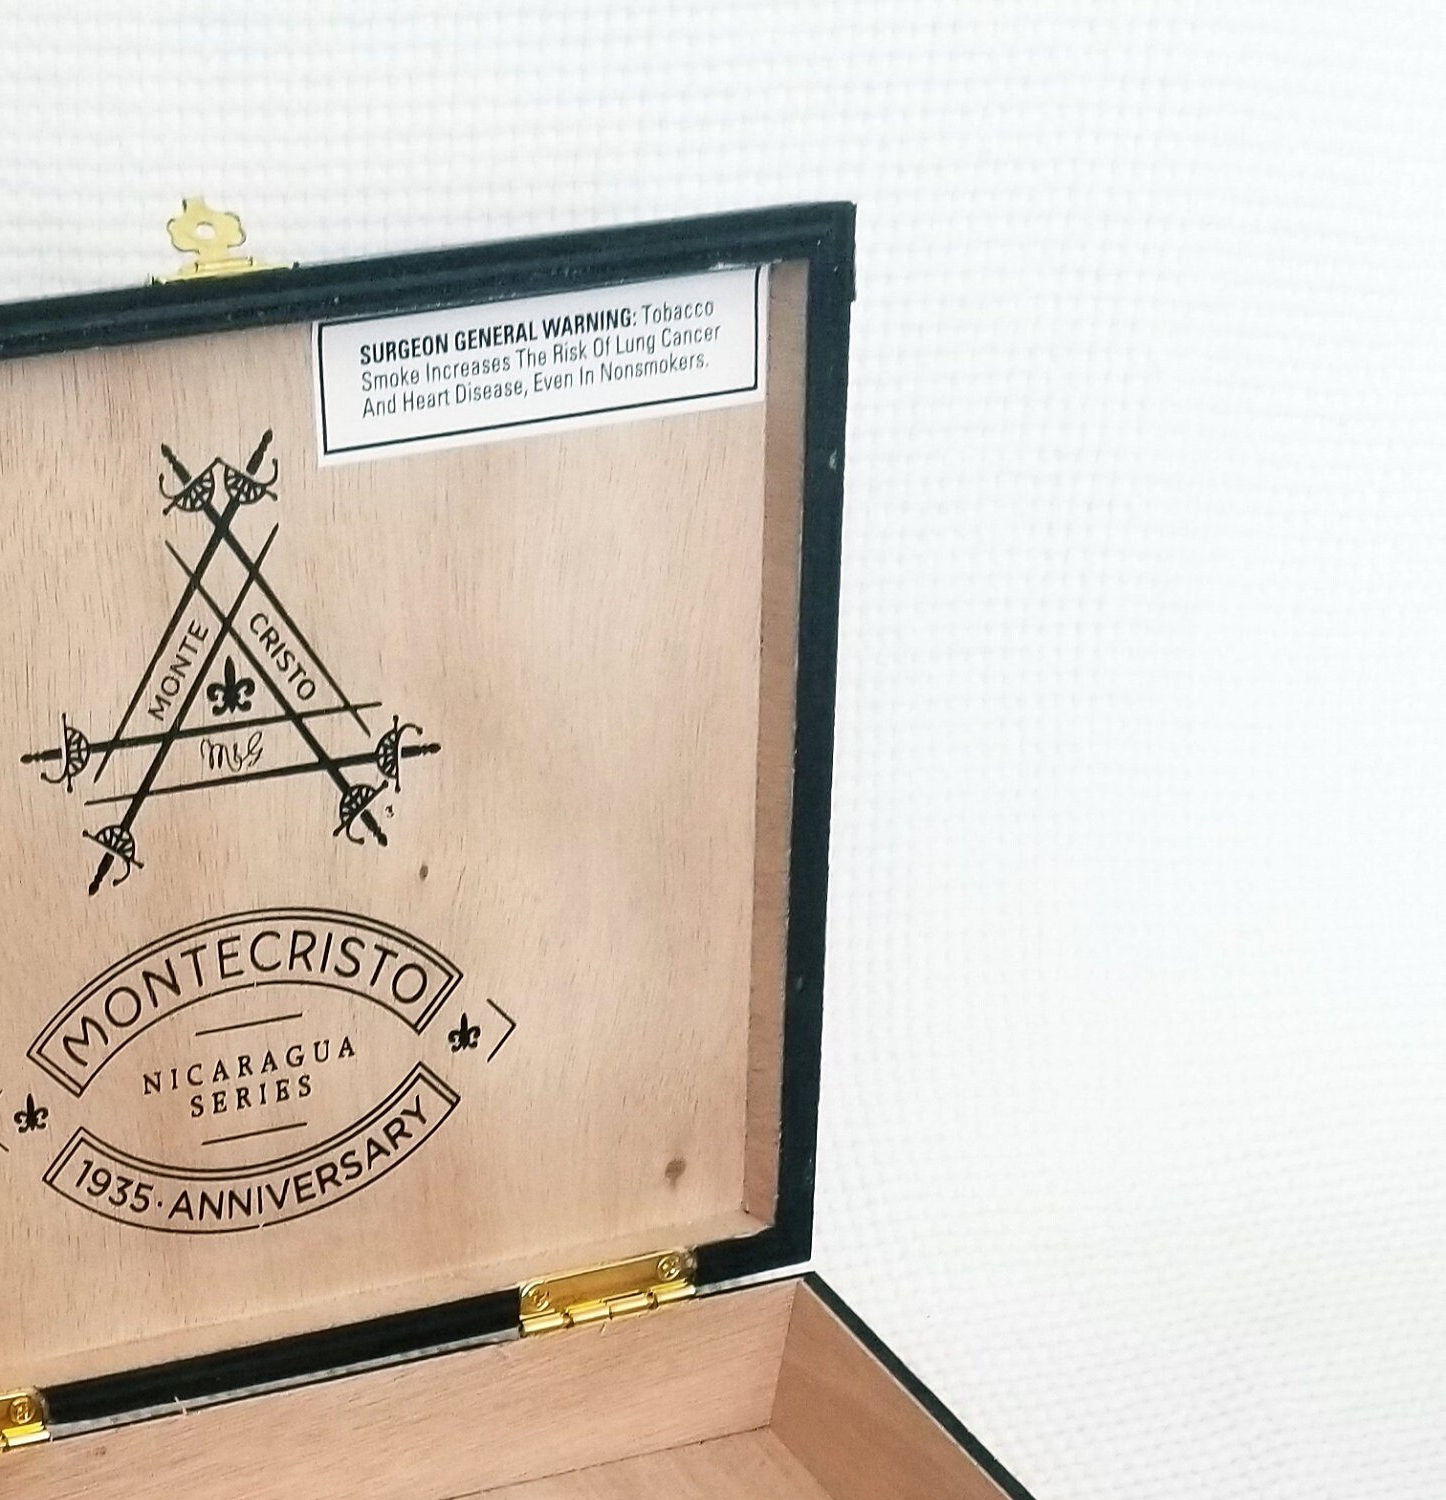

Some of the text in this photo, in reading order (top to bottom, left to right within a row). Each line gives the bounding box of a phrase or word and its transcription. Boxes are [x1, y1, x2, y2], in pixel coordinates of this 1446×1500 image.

[359, 300, 715, 366] SURGEON GENERAL WARNING: Tobacco
[361, 325, 721, 392] Smoke Increases The Risk Of Lung Cancer
[362, 352, 710, 418] And Heart Disease, Even In Nonsmokers.
[147, 618, 209, 722] MONTE
[249, 612, 317, 701] CRISTO
[61, 929, 428, 1068] MONTECRISTO
[142, 1035, 357, 1097] NICARAGUA
[189, 1074, 314, 1119] SERIES
